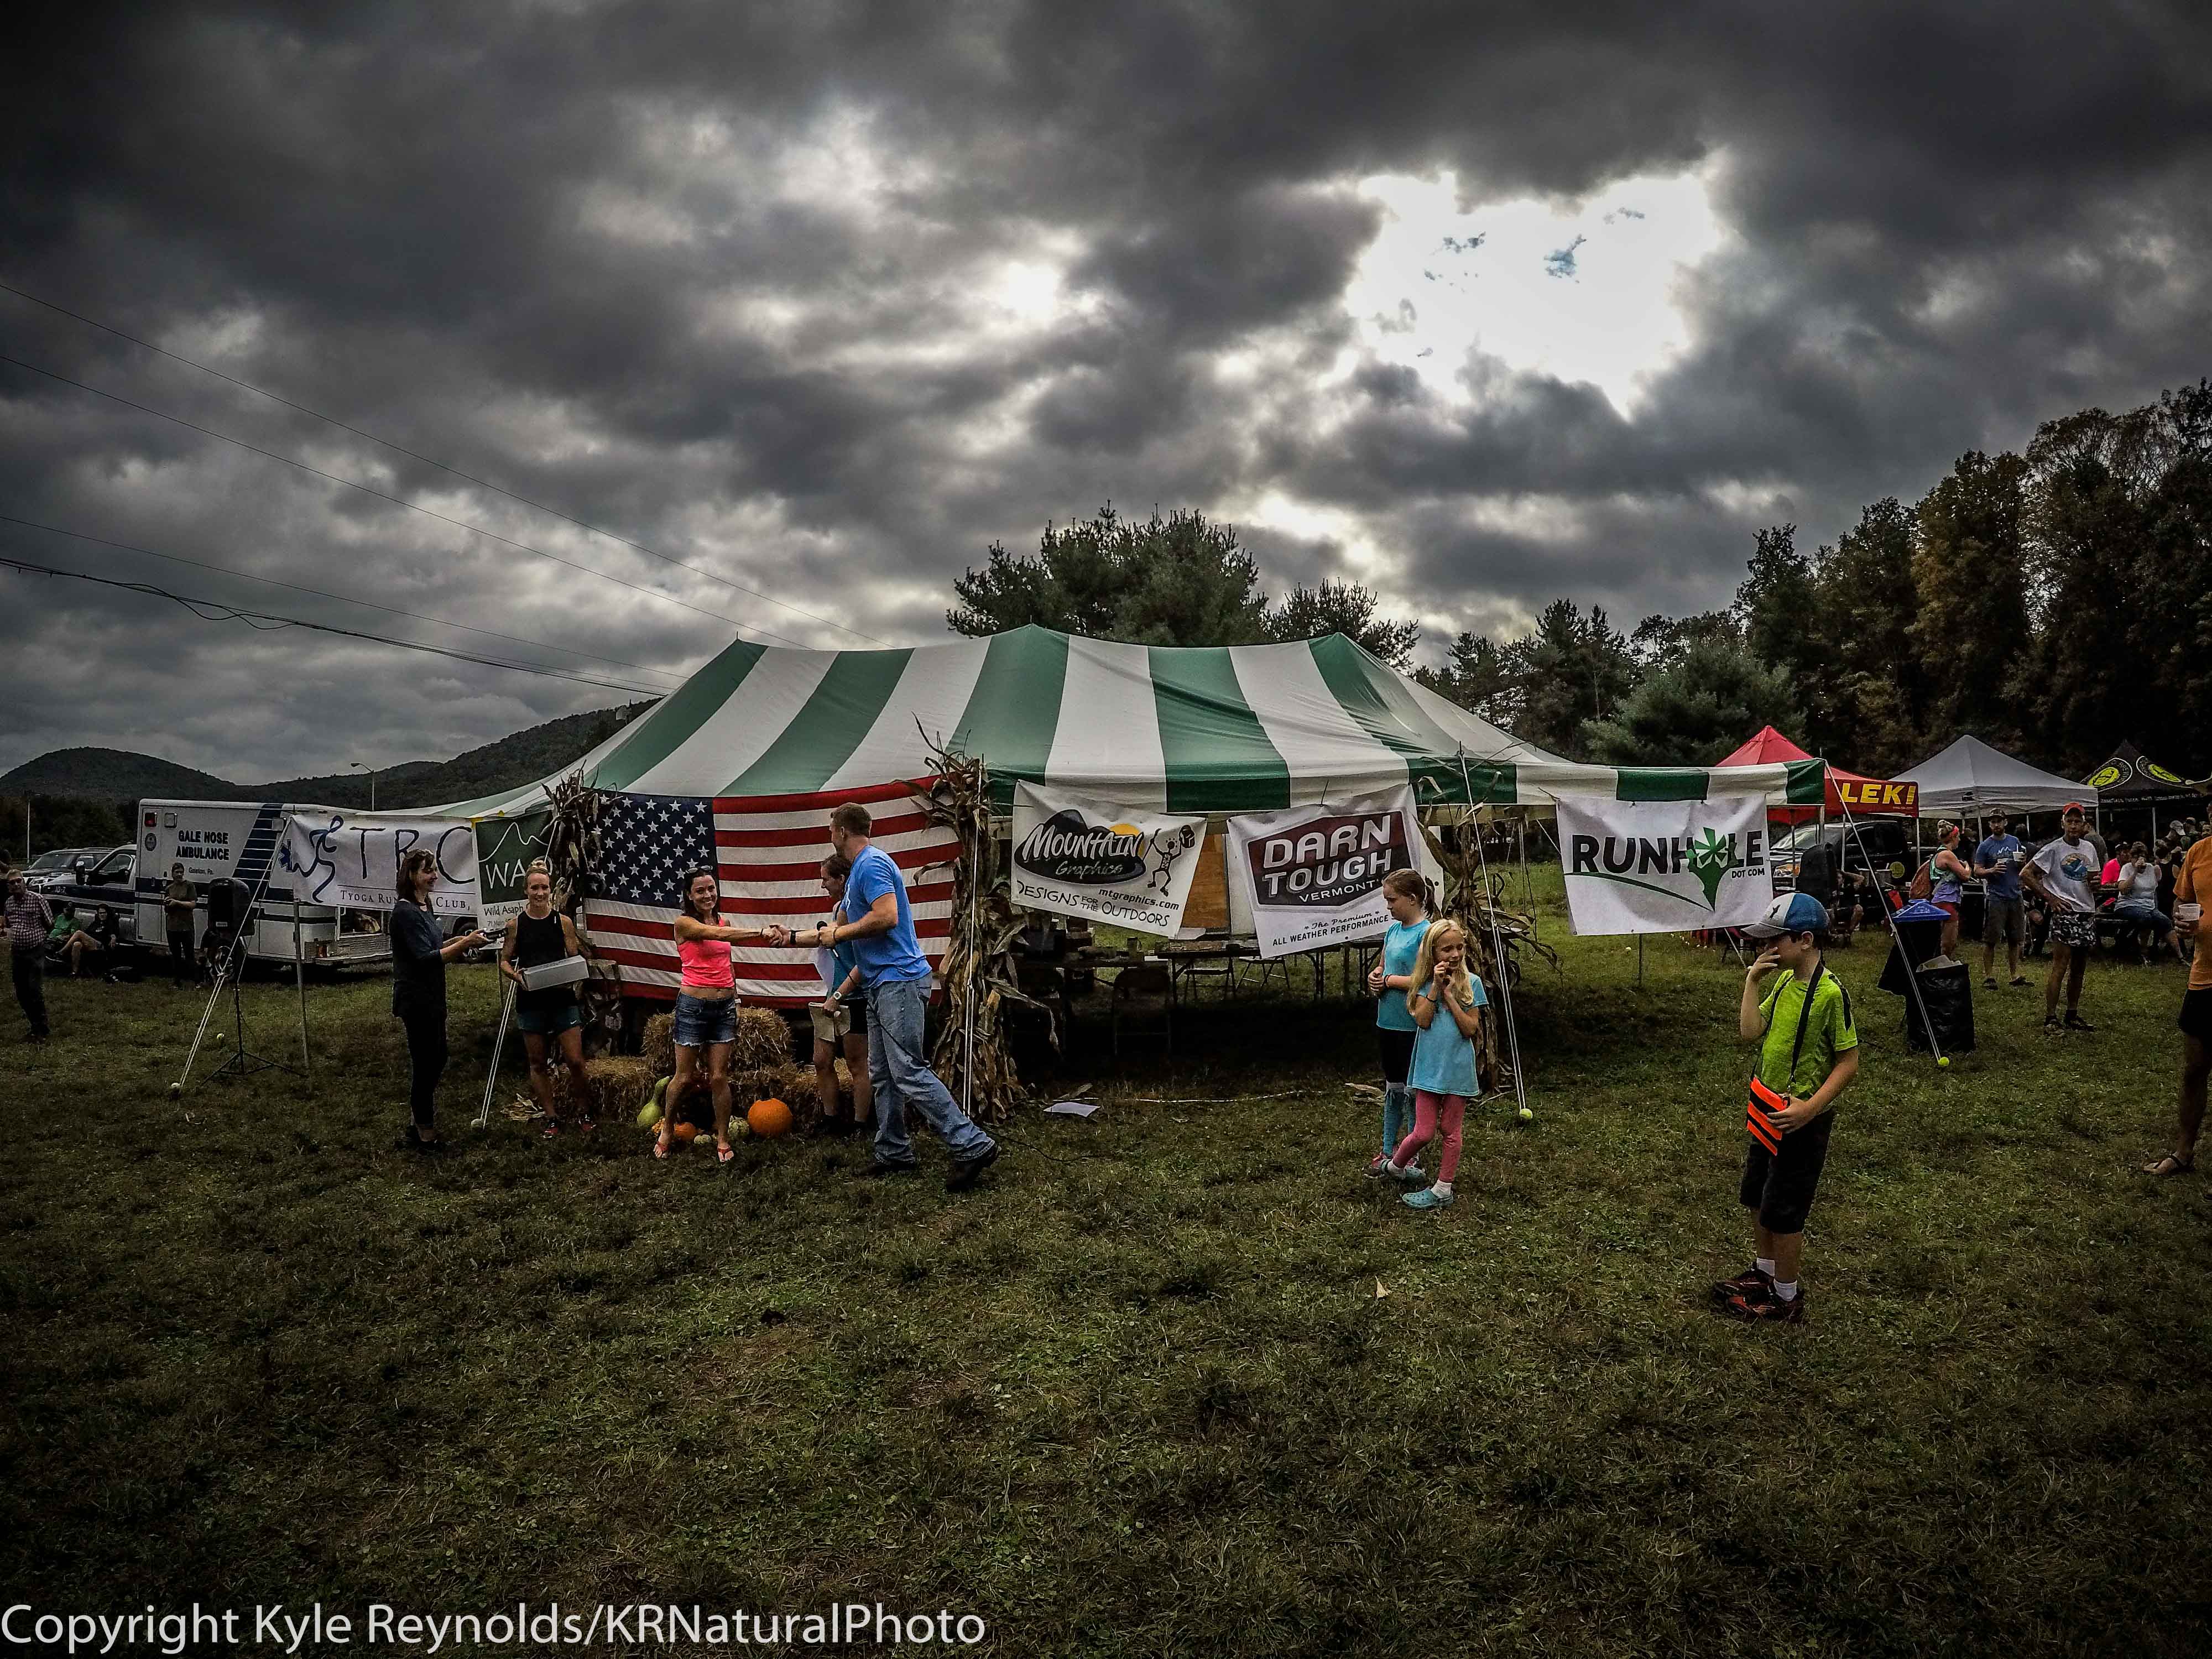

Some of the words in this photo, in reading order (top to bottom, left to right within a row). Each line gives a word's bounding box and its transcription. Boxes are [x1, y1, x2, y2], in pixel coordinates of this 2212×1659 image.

[1841, 782, 1916, 805] LEKI
[178, 830, 201, 842] GALE
[204, 831, 228, 844] HOSE
[1263, 815, 1391, 869] DARN
[176, 846, 229, 860] AMBULANCE
[1055, 860, 1124, 879] Graphics
[1262, 848, 1392, 896] TOUGH
[1747, 868, 1765, 877] COM
[1081, 896, 1098, 905] FOR
[1098, 889, 1179, 910] mtgraphics.com
[1299, 880, 1375, 902] VERMONT
[484, 905, 500, 916] Wild
[1080, 903, 1099, 912] THE
[1102, 901, 1170, 926] OUTDOORS
[1272, 937, 1287, 946] ALL
[1290, 928, 1328, 943] WEATHER
[1331, 914, 1389, 934] PERFORMANCE
[1311, 921, 1329, 930] The
[1331, 912, 1373, 926] Premium
